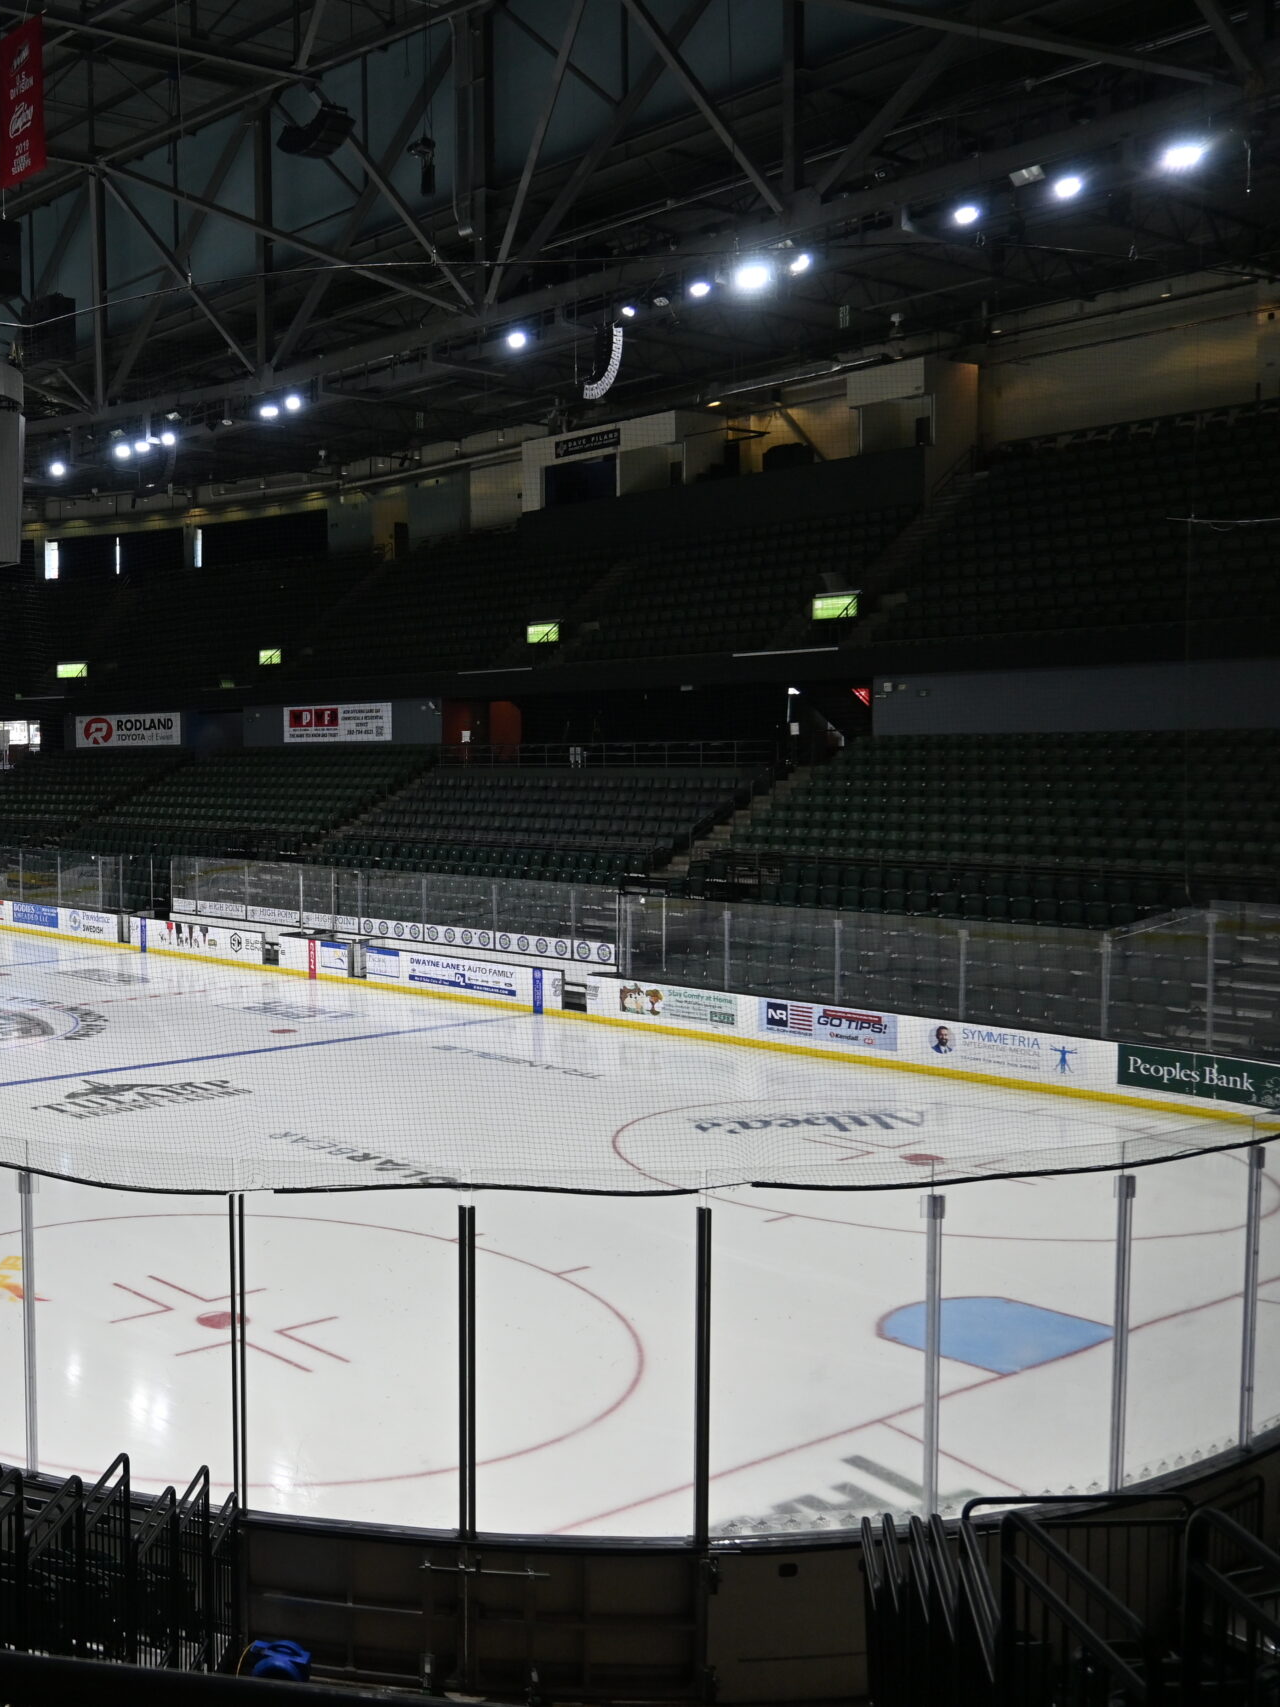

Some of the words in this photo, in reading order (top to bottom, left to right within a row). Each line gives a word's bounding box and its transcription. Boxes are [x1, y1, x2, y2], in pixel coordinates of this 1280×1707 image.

[116, 718, 173, 731] RODLAND
[116, 734, 145, 742] TOYOTA
[147, 733, 153, 741] of
[208, 902, 223, 911] HIGH
[225, 904, 244, 913] POINT
[259, 908, 276, 917] HIGH
[278, 910, 298, 920] POINT
[334, 915, 355, 926] POINT
[82, 924, 104, 934] SWEDISH
[410, 957, 440, 968] DWAYNE
[467, 965, 487, 975] AUTO
[488, 968, 514, 979] FAMILY
[668, 989, 682, 998] Stay
[683, 991, 705, 1000] Comfy
[713, 995, 733, 1004] Home
[817, 1015, 842, 1027] GO
[845, 1019, 888, 1035] TIPS!
[835, 1032, 859, 1041] Kendall
[962, 1028, 1041, 1050] SYMMETRIA
[1009, 1046, 1041, 1058] MEDICAL
[1128, 1056, 1200, 1085] Peoples
[1204, 1063, 1255, 1092] Bank
[269, 1131, 472, 1191] OLARBEAR
